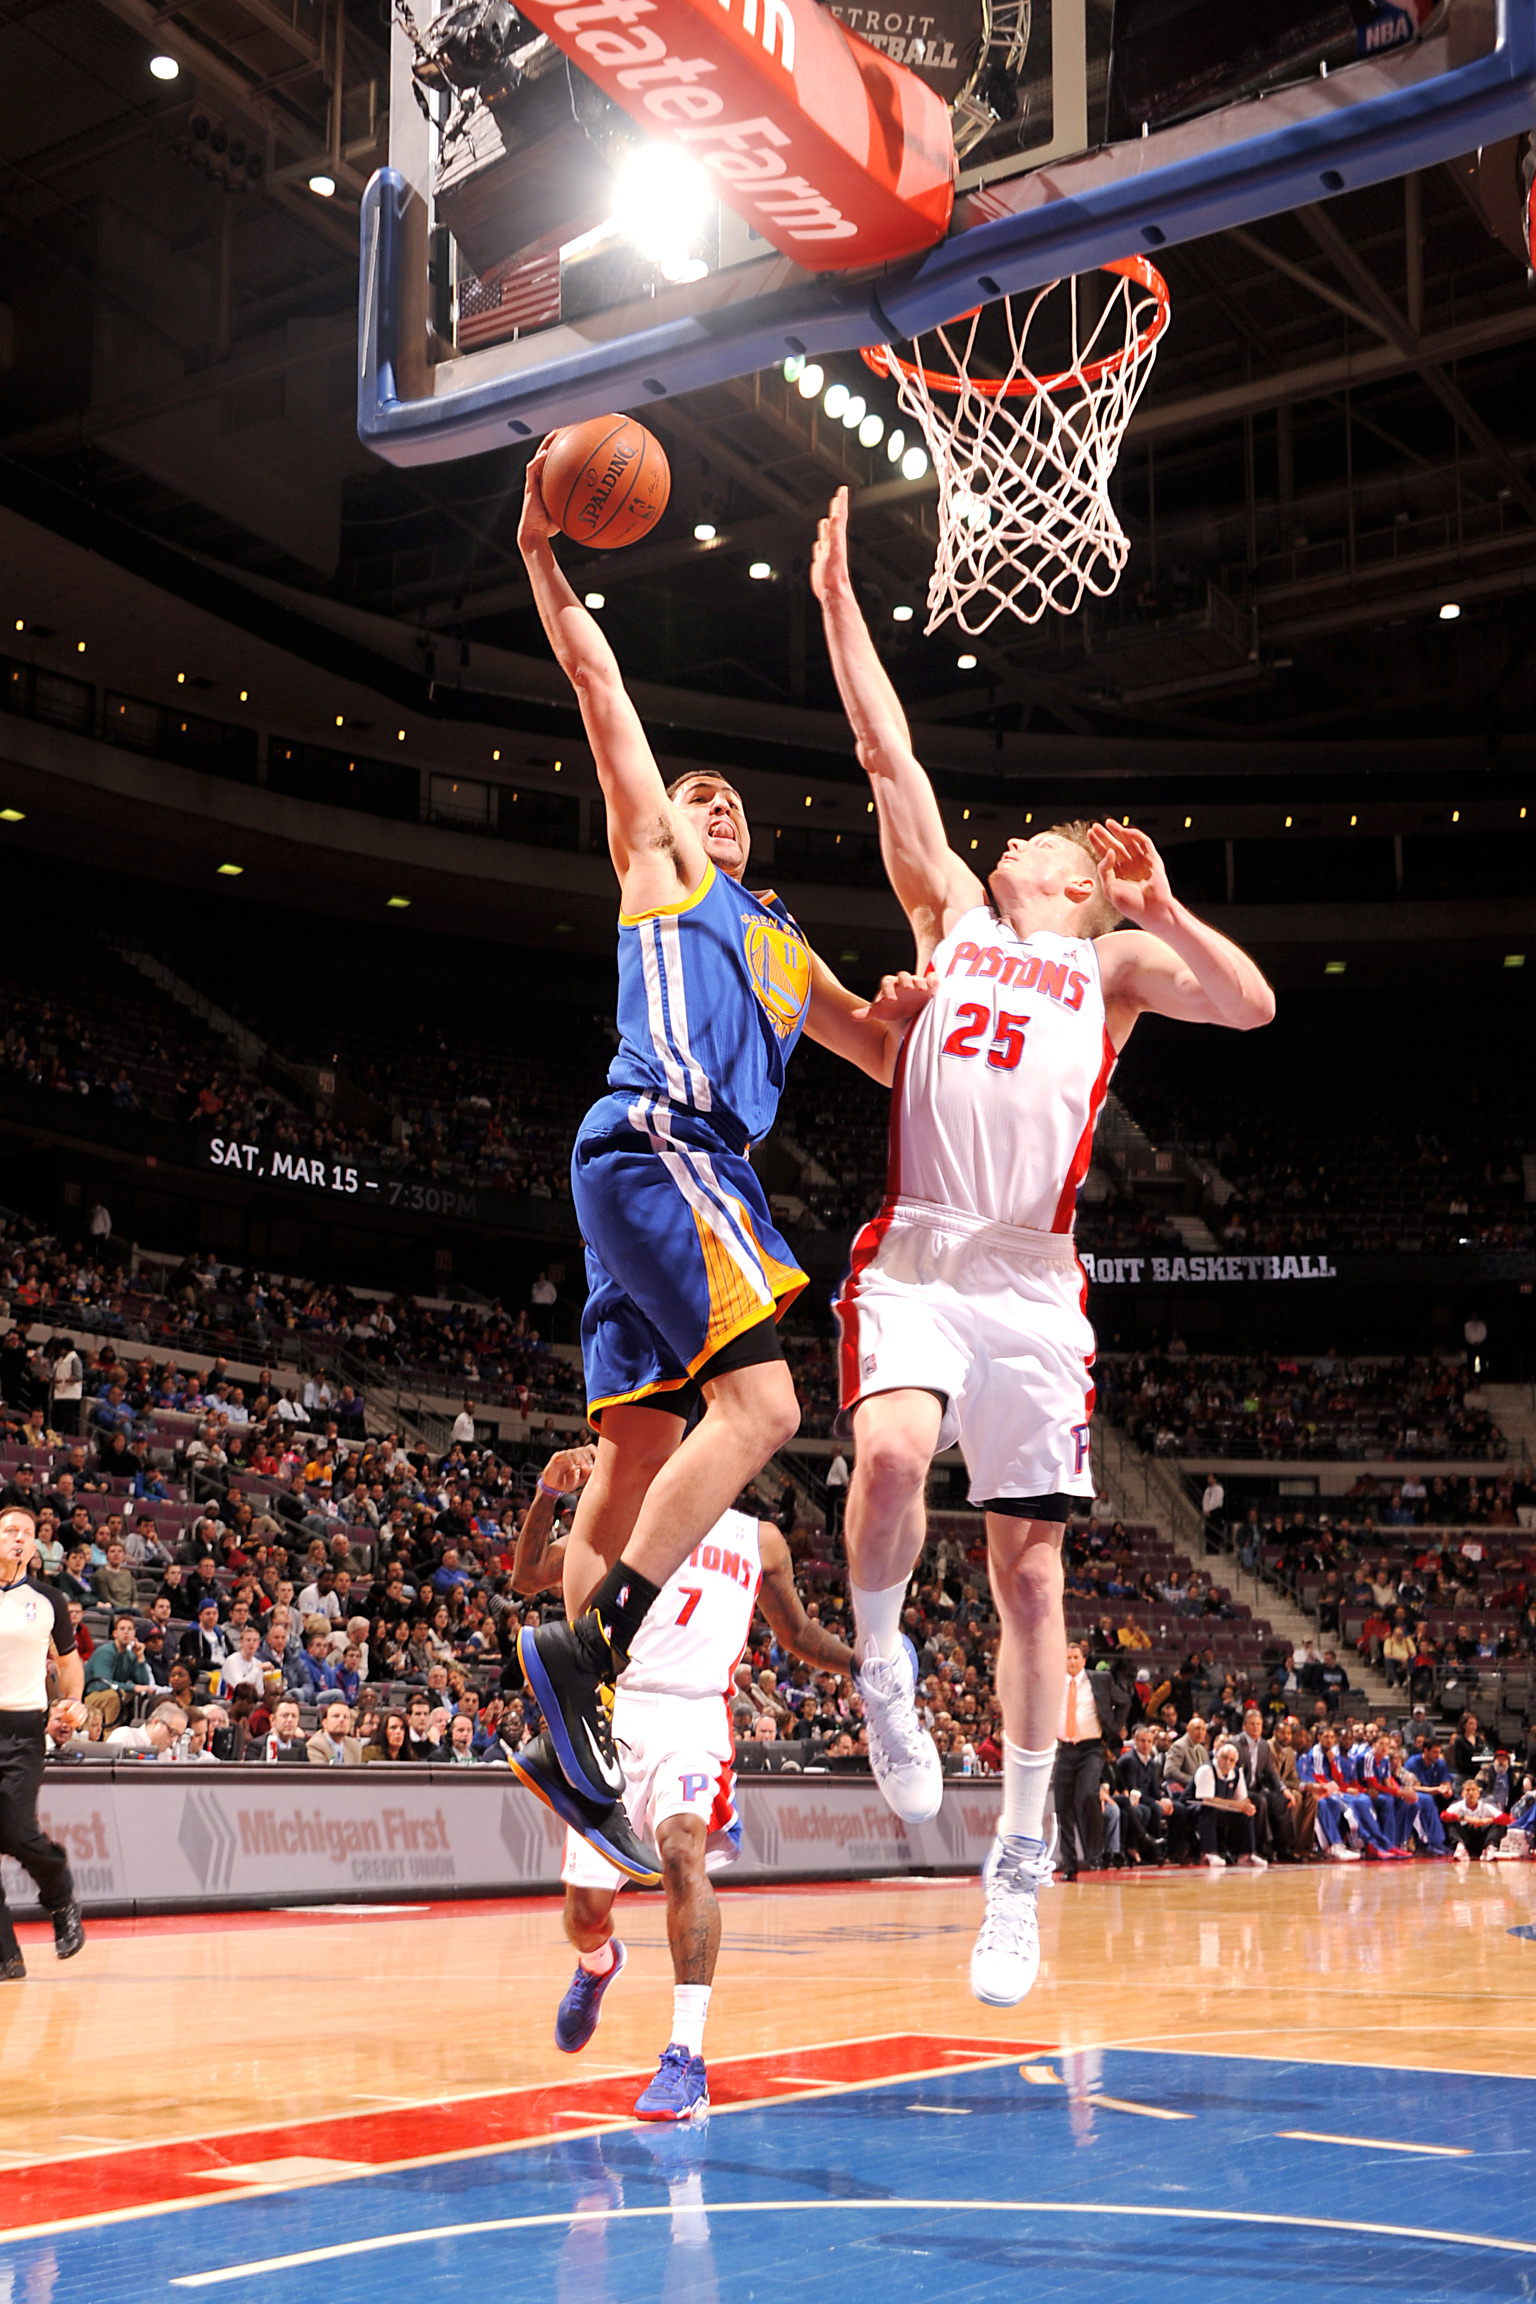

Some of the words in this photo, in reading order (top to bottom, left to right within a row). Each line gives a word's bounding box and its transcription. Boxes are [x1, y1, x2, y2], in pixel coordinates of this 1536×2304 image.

[831, 6, 935, 36] ETROIT
[1365, 16, 1409, 51] NBA
[535, 0, 724, 120] tate
[577, 441, 639, 529] SPALDING
[783, 941, 798, 970] 11
[945, 941, 1091, 1011] PISTONS
[941, 1002, 1032, 1072] 25
[209, 1138, 264, 1177] SAT,
[271, 1152, 326, 1187] MAR
[331, 1165, 358, 1193] 15
[388, 1182, 478, 1218] 7:30PM
[1078, 1253, 1145, 1283] ROIT
[1151, 1255, 1337, 1282] BASKETBALL
[689, 1543, 754, 1591] TONS
[674, 1586, 704, 1628] 7
[678, 1773, 709, 1802] P
[37, 1810, 110, 1860] irst
[236, 1807, 382, 1863] Michigan
[381, 1806, 452, 1851] First
[351, 1857, 405, 1882] CREDIT
[409, 1854, 457, 1879] UNION
